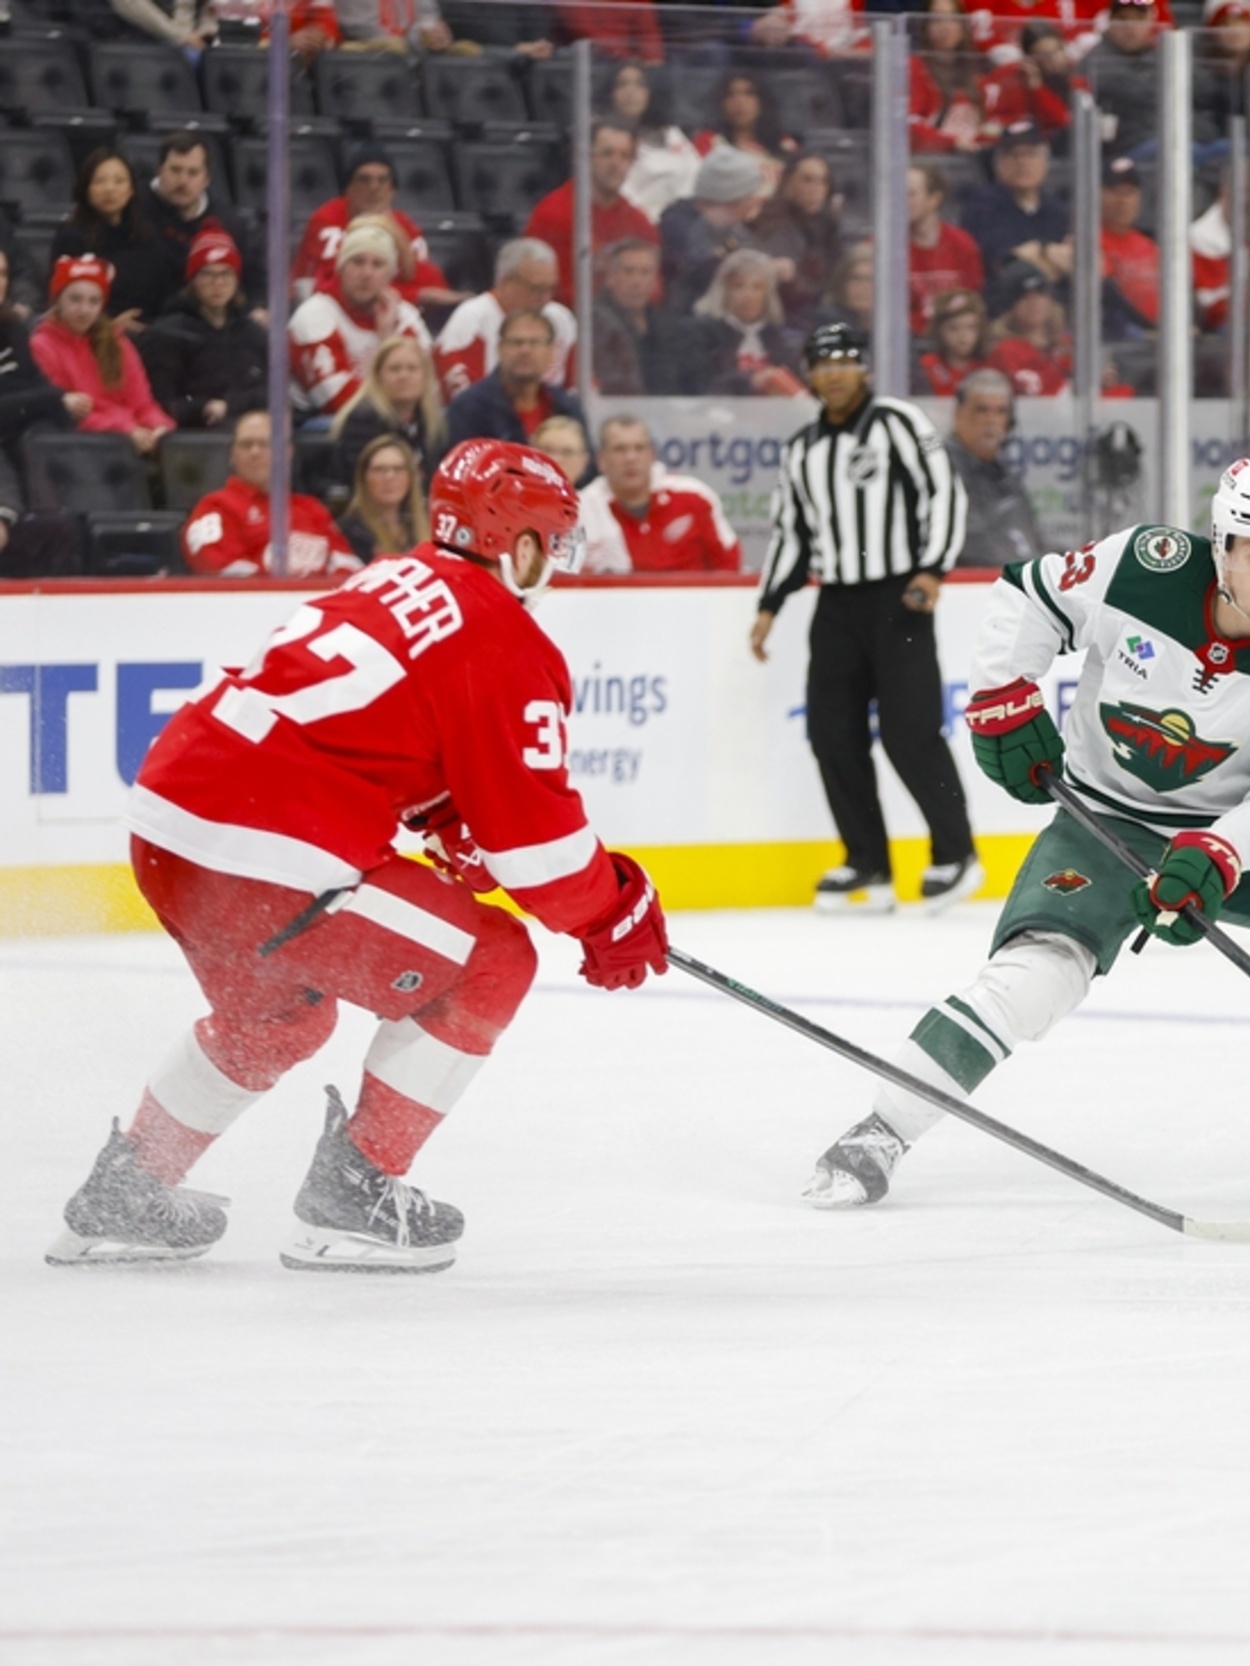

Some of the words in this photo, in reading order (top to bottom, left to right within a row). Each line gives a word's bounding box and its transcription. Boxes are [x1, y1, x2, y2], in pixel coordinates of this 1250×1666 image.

[656, 431, 784, 485] ortga
[434, 512, 458, 543] 37
[339, 556, 464, 661] PHER
[1118, 649, 1148, 680] TRIA
[522, 699, 566, 771] 3
